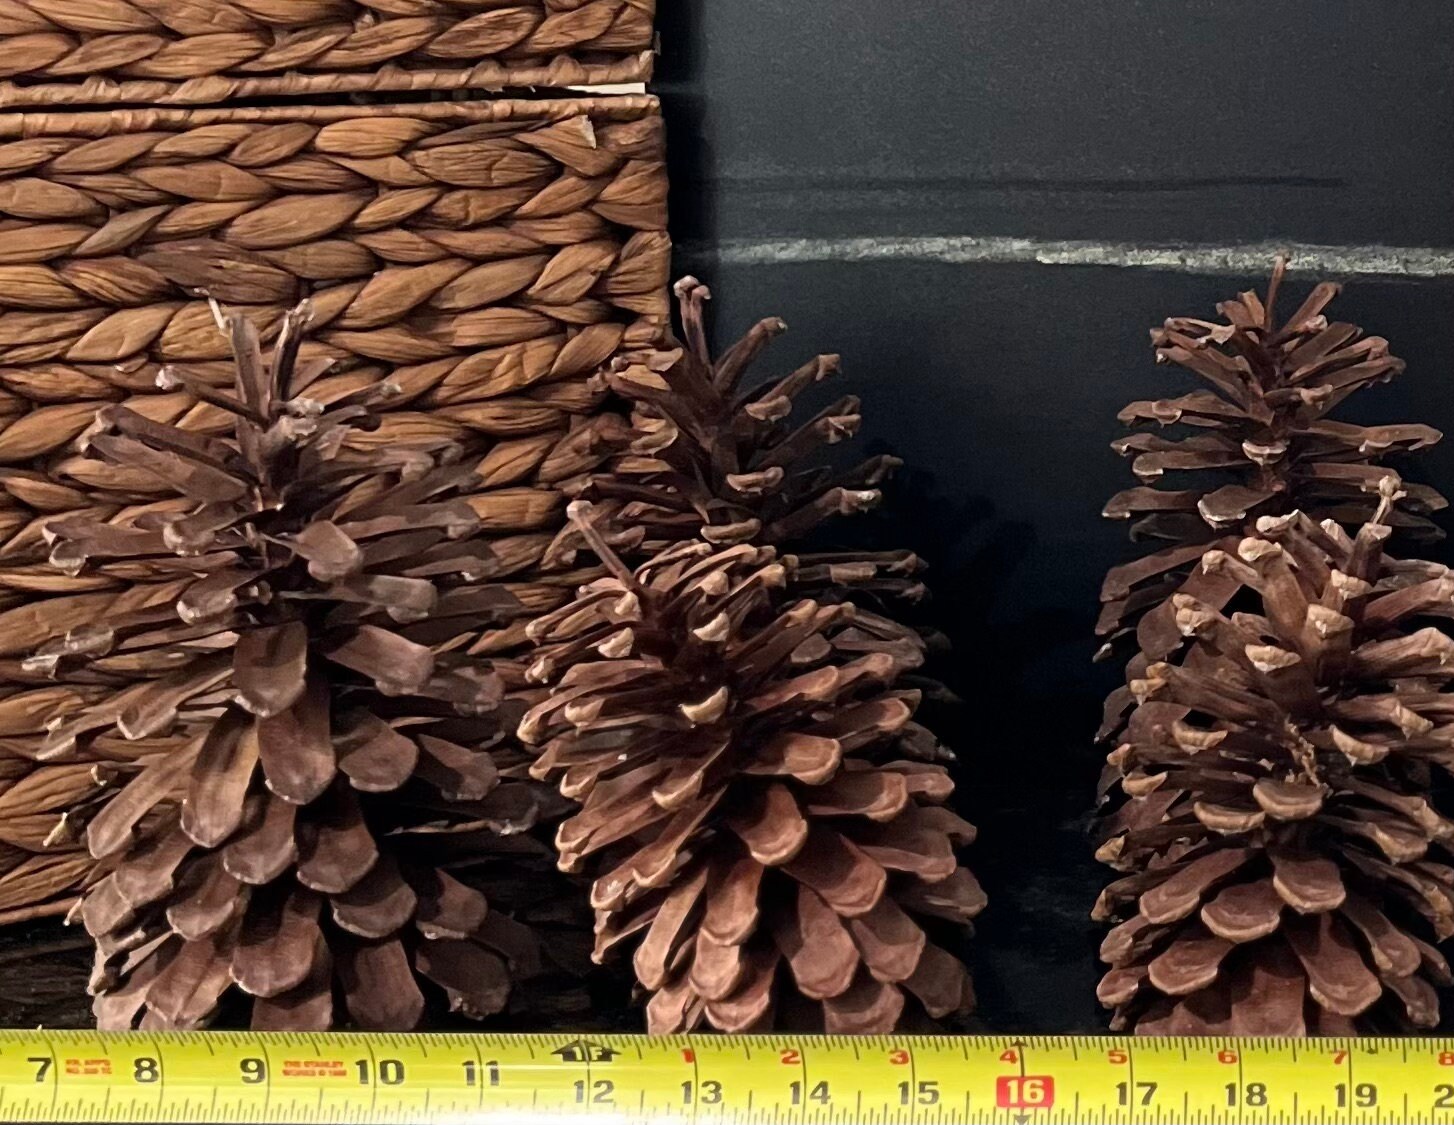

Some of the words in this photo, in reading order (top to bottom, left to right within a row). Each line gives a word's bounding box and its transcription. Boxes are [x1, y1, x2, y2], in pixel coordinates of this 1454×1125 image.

[682, 1049, 695, 1063] 1
[780, 1050, 800, 1064] 2
[889, 1050, 910, 1065] 3
[1000, 1050, 1018, 1064] 4
[1108, 1050, 1128, 1064] 5
[1218, 1050, 1238, 1064] 6
[1332, 1050, 1349, 1064] 7
[27, 1057, 52, 1082] 7
[134, 1057, 160, 1082] 8
[240, 1058, 265, 1083] 9
[354, 1059, 404, 1085] 10
[462, 1060, 500, 1086] 11
[573, 1080, 614, 1104] 12
[681, 1081, 723, 1104] 13
[789, 1081, 831, 1105] 14
[898, 1081, 940, 1105] 15
[1006, 1079, 1044, 1104] 16
[1115, 1082, 1158, 1106] 17
[1225, 1083, 1268, 1107] 18
[1335, 1083, 1378, 1107] 19
